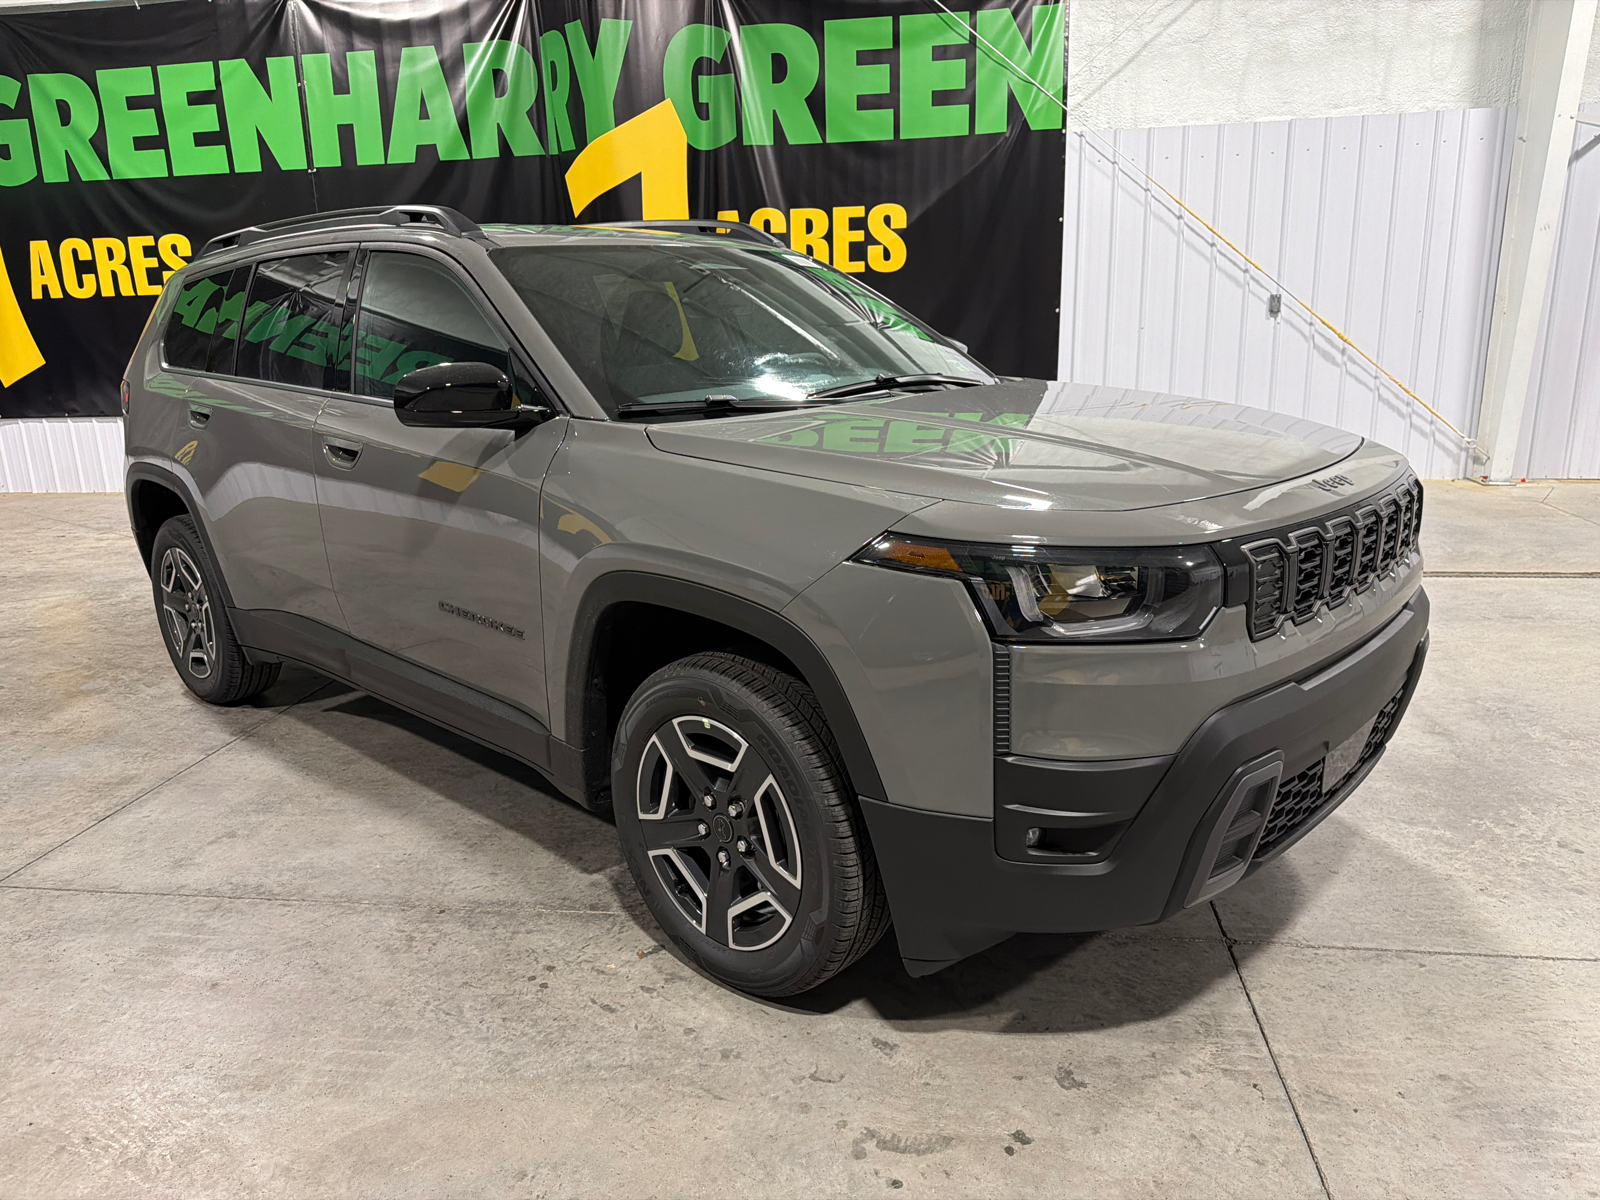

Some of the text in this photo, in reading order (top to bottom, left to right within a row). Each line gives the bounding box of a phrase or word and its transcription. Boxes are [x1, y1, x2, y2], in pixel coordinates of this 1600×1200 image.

[302, 3, 1065, 168] HARRY GREEN
[0, 56, 308, 187] GREEN
[29, 233, 193, 300] ACRES
[716, 203, 908, 274] RES
[1311, 473, 1355, 492] Jeep
[438, 600, 526, 641] CHEROKEE
